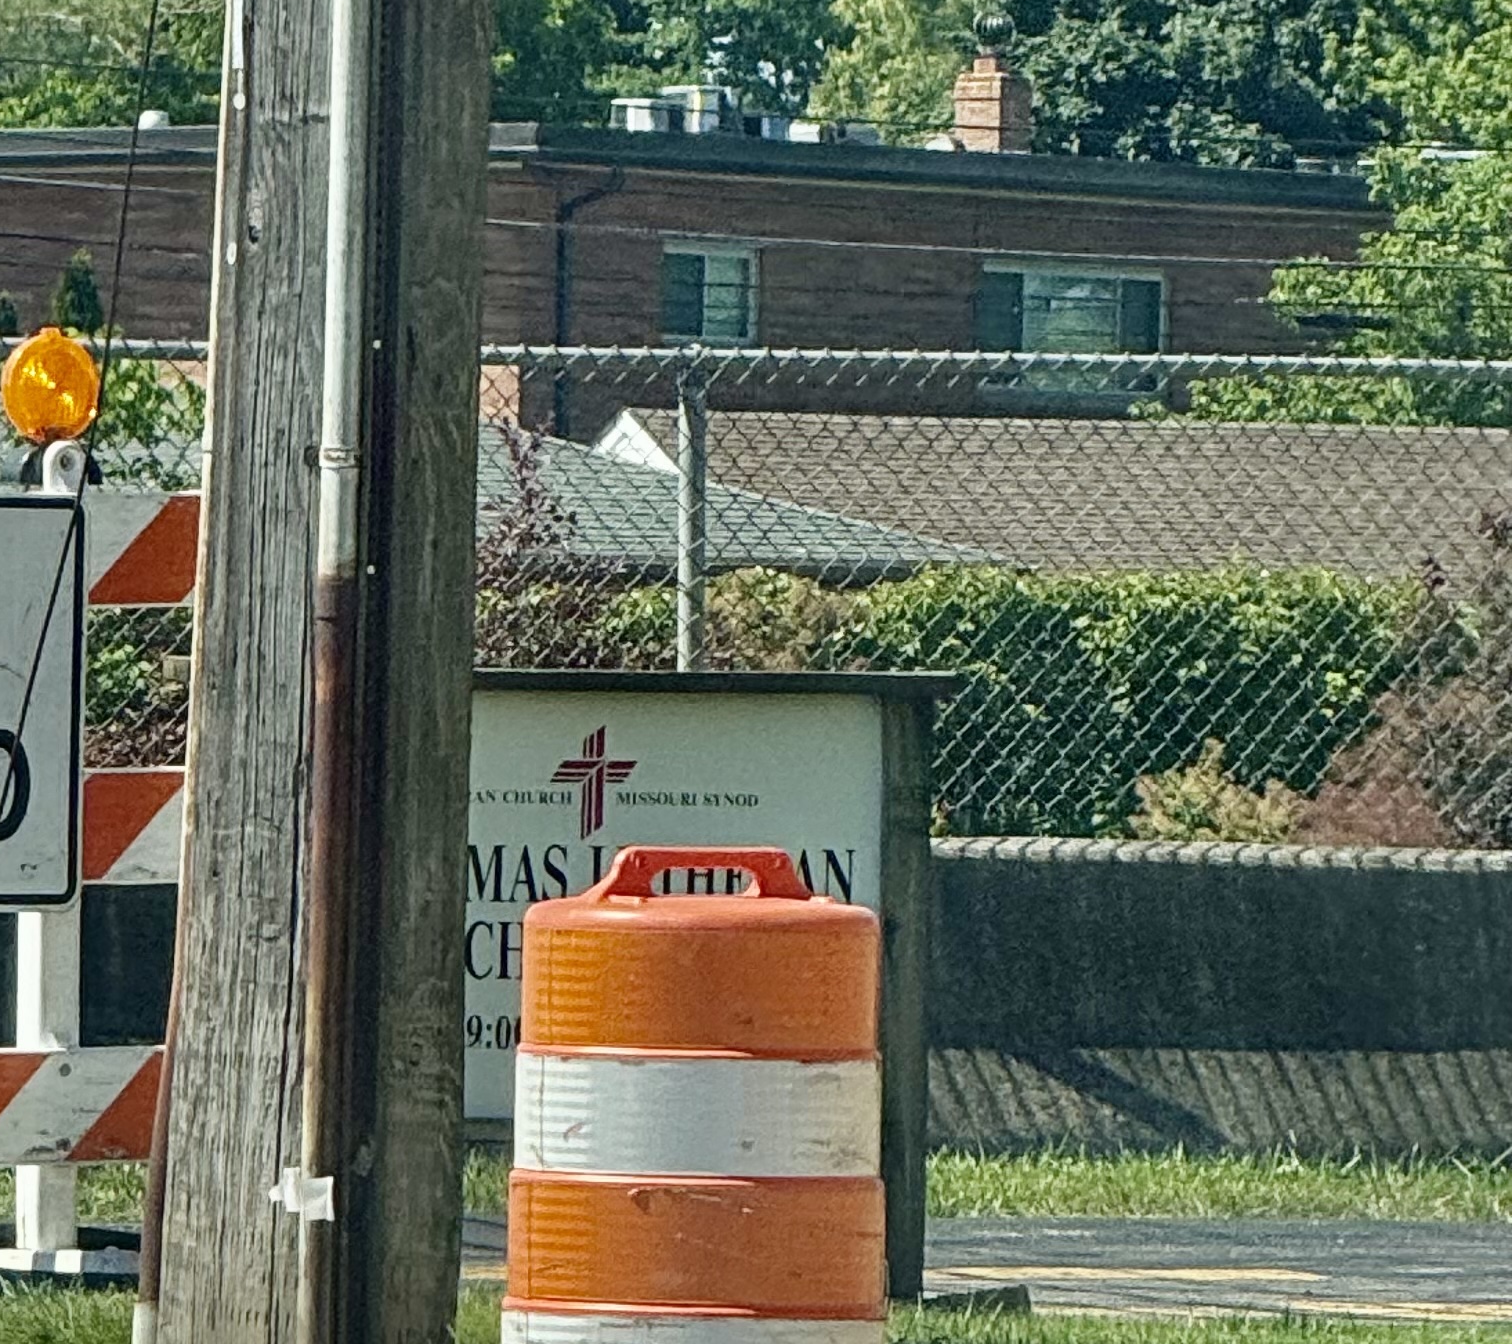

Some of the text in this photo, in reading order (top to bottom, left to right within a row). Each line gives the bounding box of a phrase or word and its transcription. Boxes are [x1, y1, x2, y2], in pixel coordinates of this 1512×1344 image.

[468, 788, 759, 807] AN CHURCH MISSOURI SYNOD
